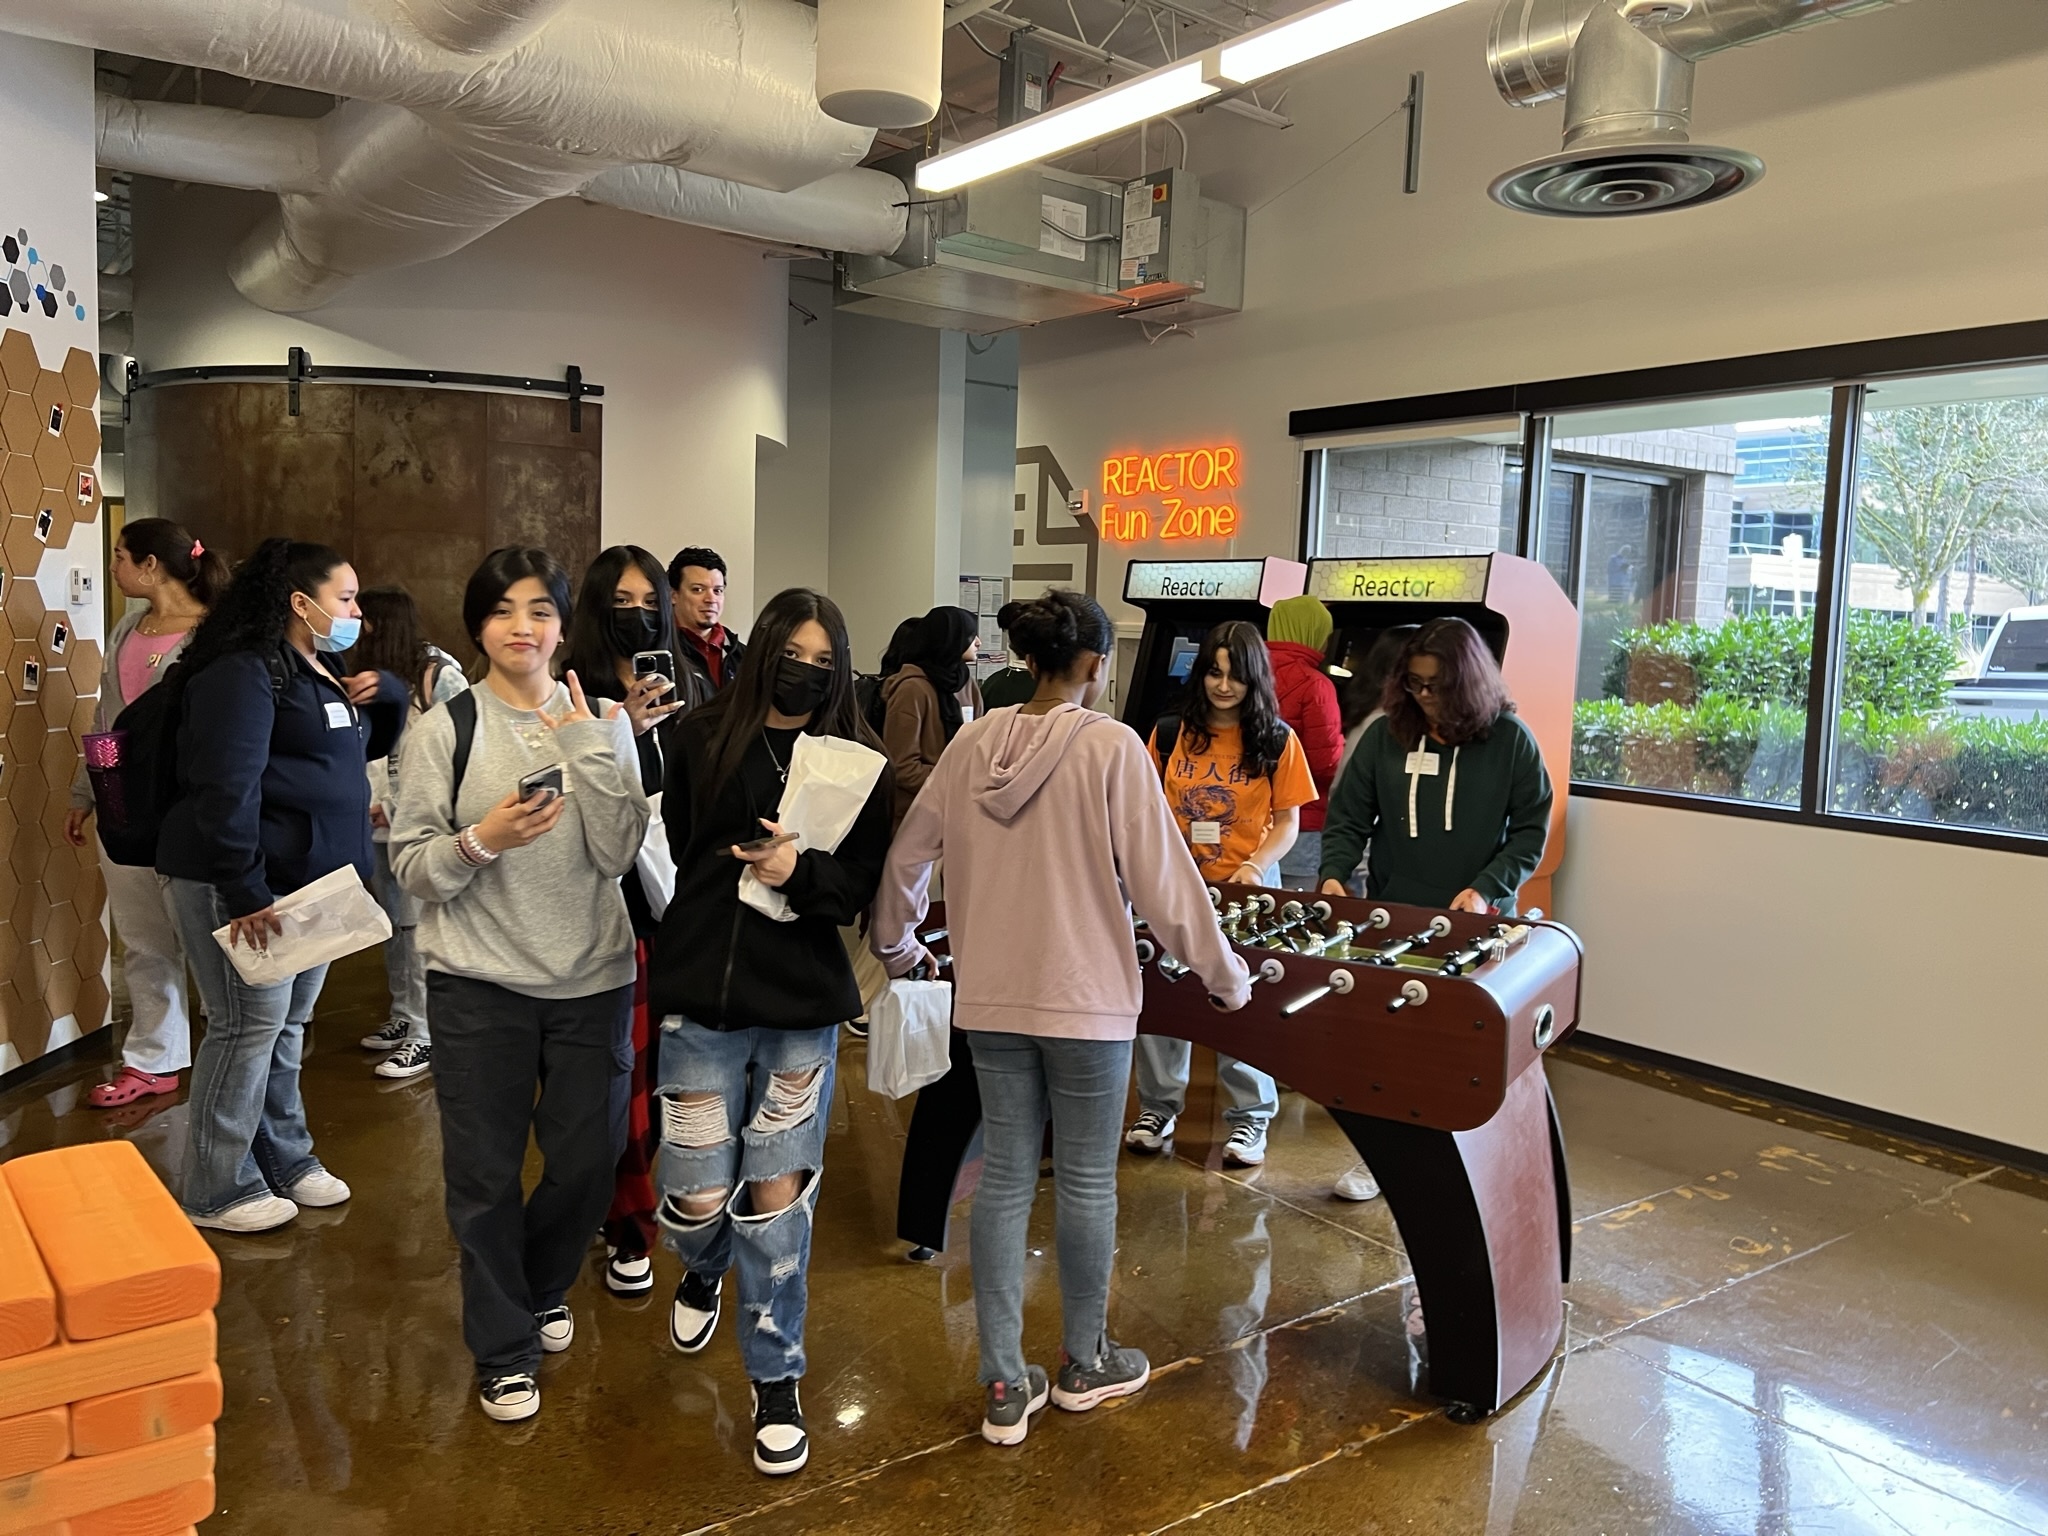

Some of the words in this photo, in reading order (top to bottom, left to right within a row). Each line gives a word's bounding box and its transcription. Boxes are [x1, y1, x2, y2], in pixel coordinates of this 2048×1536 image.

[1103, 447, 1237, 496] REACTOR
[1101, 502, 1147, 540] Fun
[1159, 498, 1236, 539] Zone
[1160, 576, 1224, 597] Reactor
[1352, 574, 1435, 598] Reactor
